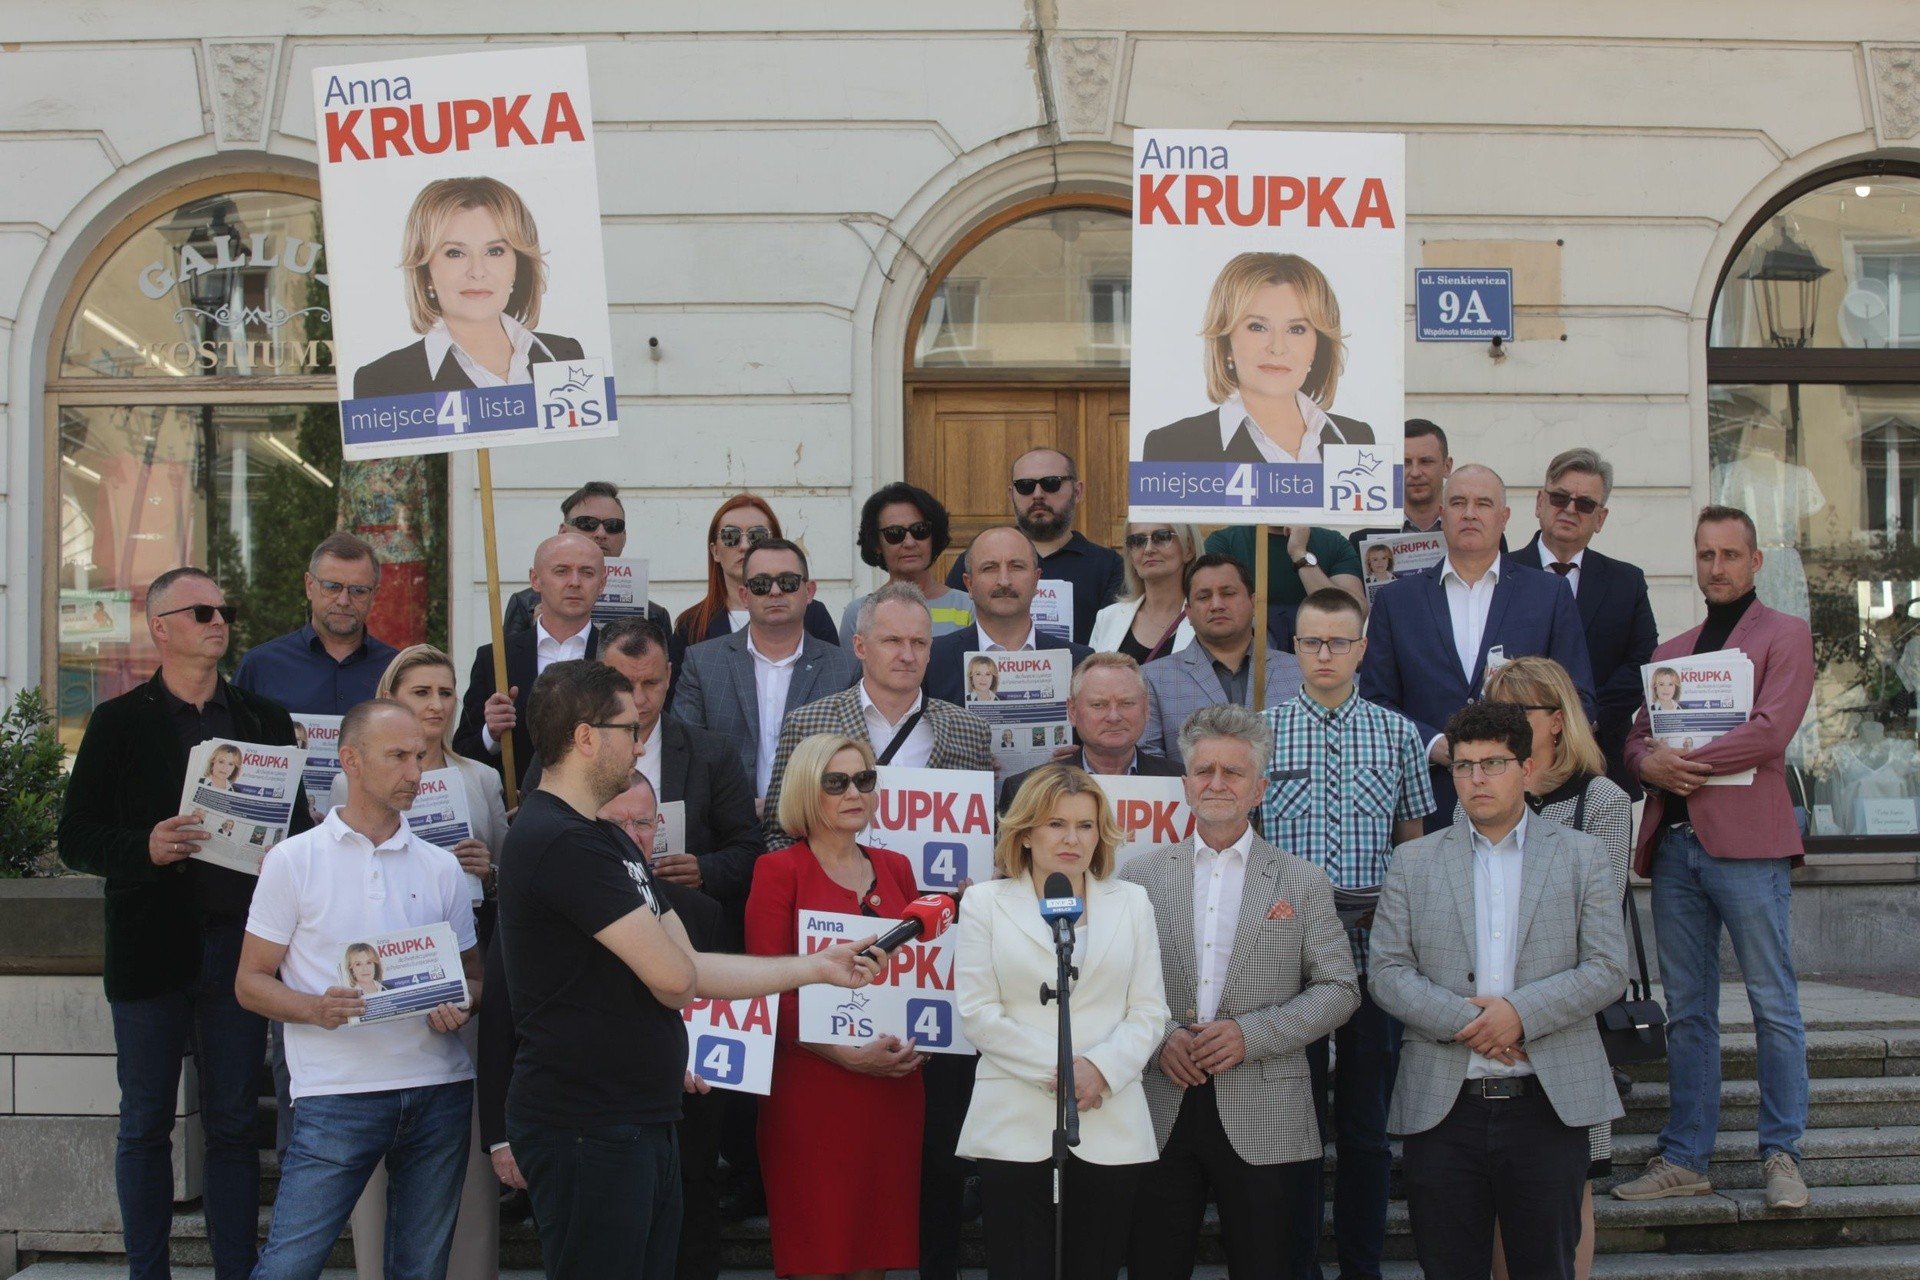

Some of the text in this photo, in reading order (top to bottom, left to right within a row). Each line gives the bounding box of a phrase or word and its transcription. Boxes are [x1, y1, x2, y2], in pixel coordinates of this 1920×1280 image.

[325, 75, 411, 107] Anna
[325, 92, 586, 164] KRUPKA
[1140, 138, 1228, 170] Anna
[1139, 174, 1395, 229] KRUPKA
[138, 233, 329, 299] GALLU
[1421, 275, 1506, 285] ul. Sienkiewicza
[1438, 290, 1491, 323] 9A
[1423, 328, 1507, 336] Wspólnota Mieszkaniowa
[351, 390, 525, 434] miejsce 4 lista
[542, 399, 602, 430] PiS
[1140, 463, 1314, 506] miejsce 4 lista
[1329, 485, 1388, 512] PiS
[1392, 540, 1439, 555] KRUPKA
[998, 660, 1051, 672] KRUPKA
[1681, 671, 1732, 682] KRUPKA
[243, 753, 288, 769] KRUPKA
[871, 789, 991, 834] UPKA
[930, 849, 957, 882] 4
[807, 917, 844, 933] Anna
[378, 936, 435, 958] KRUPKA
[831, 1015, 873, 1038] PiS
[914, 1006, 941, 1041] 4
[703, 1044, 732, 1078] 4
